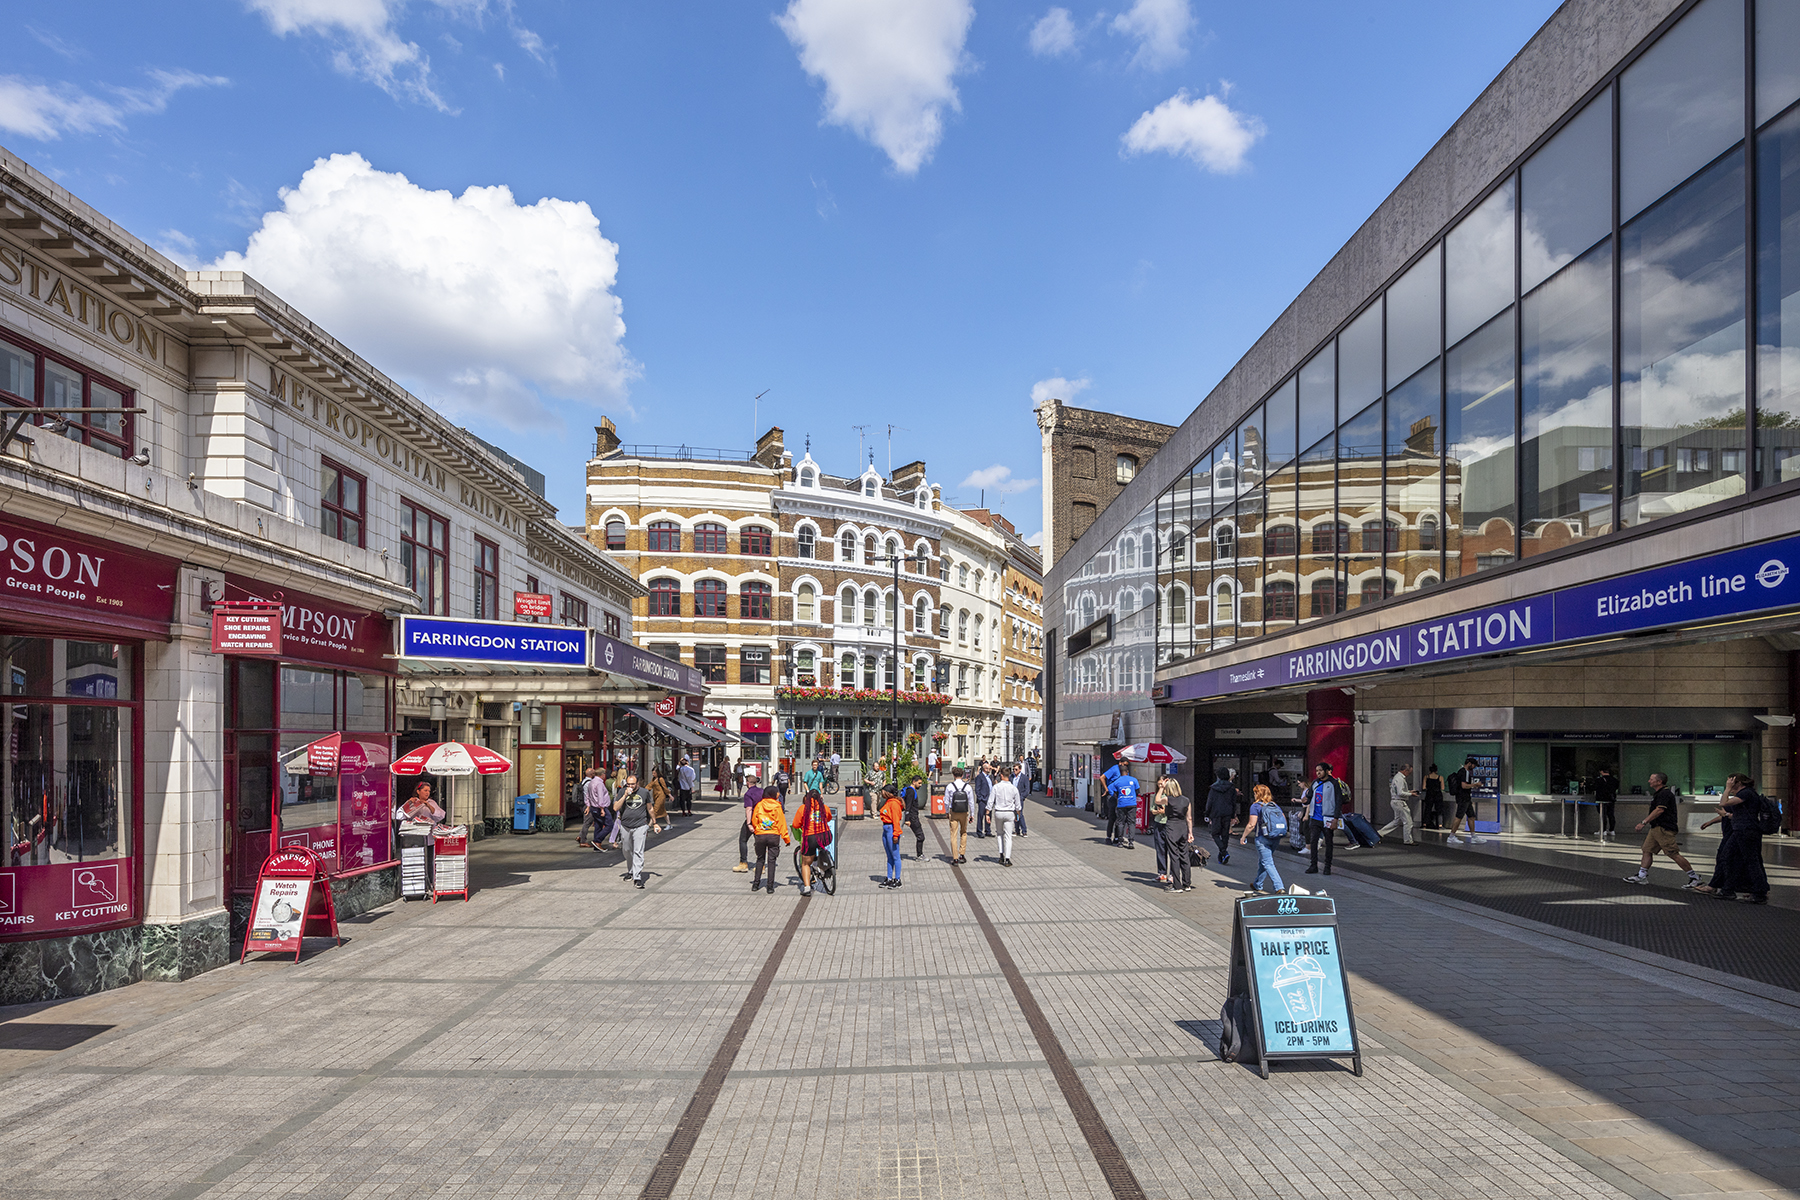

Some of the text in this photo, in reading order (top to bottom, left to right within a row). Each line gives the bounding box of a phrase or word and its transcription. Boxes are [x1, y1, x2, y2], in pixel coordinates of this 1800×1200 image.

[0, 246, 159, 361] STATION
[268, 366, 520, 533] METROPOLITAN RAILWAY
[556, 558, 562, 574] &
[562, 561, 580, 583] HIGH
[5, 576, 87, 601] Great People
[1596, 574, 1746, 617] Elizabeth line
[96, 595, 124, 608] Est 1903
[516, 597, 538, 606] Weight
[241, 616, 269, 624] CUTTING
[220, 641, 274, 649] WATCH REPAIRS
[300, 634, 310, 645] By
[310, 637, 327, 647] Great
[328, 639, 348, 651] People
[412, 631, 579, 653] FARRINGDON STATION
[1229, 606, 1531, 684] Thameslink FARRINGDON STATION
[632, 656, 663, 677] FARRINGDON
[663, 665, 680, 682] STATION
[312, 839, 335, 851] PHONE
[270, 853, 312, 868] TIMPSON
[269, 888, 299, 897] Repairs
[55, 903, 128, 921] KEY CUTTING
[1260, 940, 1331, 956] HALF PRICE
[1275, 1020, 1338, 1034] ICED DRINKS
[1286, 1036, 1305, 1046] 2PM
[1312, 1036, 1330, 1046] 5PM
